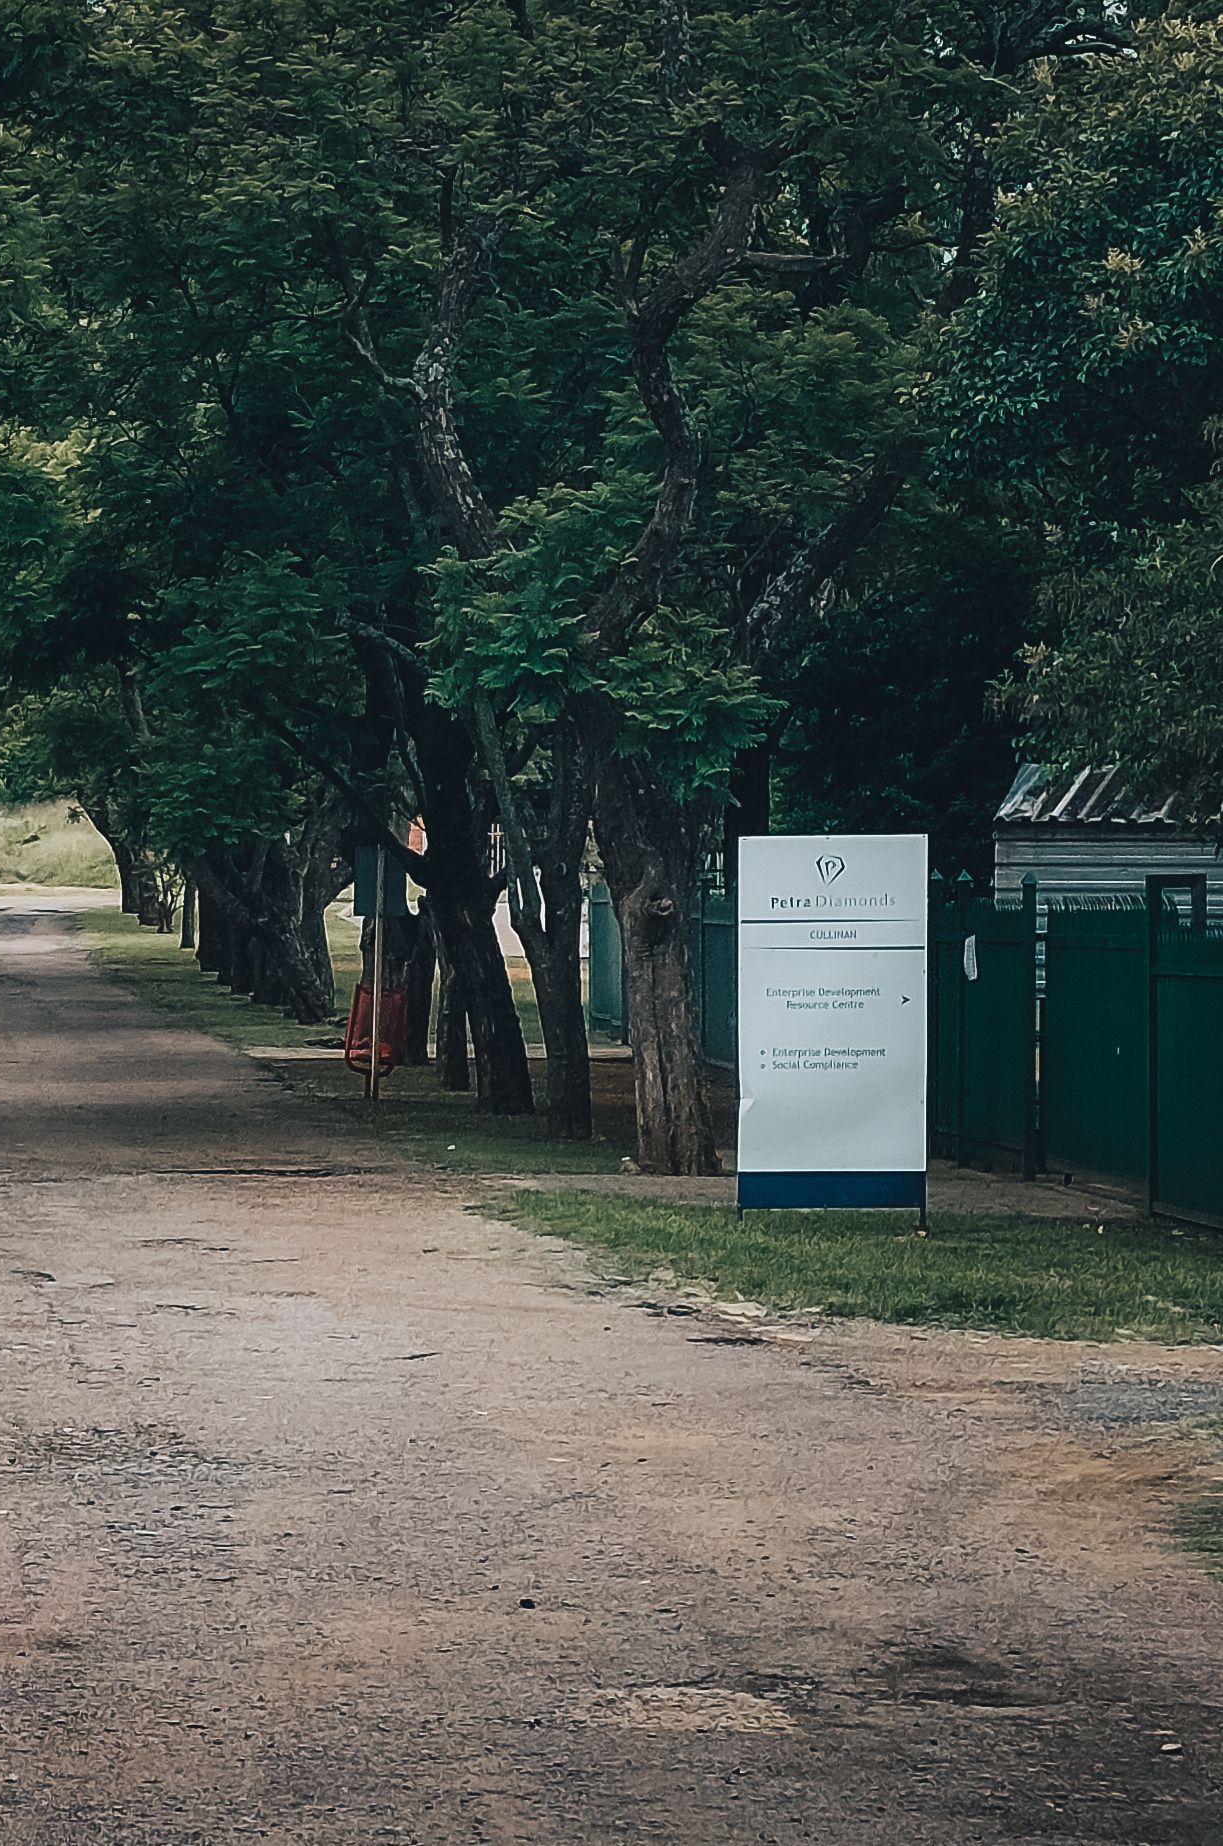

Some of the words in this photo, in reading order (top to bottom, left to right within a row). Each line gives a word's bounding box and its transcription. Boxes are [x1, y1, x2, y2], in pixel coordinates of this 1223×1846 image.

[771, 897, 811, 909] Petra
[816, 893, 896, 907] Diamonds
[810, 930, 857, 940] CULLINAN
[766, 988, 815, 999] Enterprise
[818, 987, 881, 998] Development
[786, 1000, 829, 1009] Resource
[832, 1000, 864, 1009] Centre
[772, 1048, 821, 1058] Enterprise
[824, 1047, 886, 1057] Development
[772, 1060, 800, 1070] Social
[803, 1060, 859, 1071] Compliance
